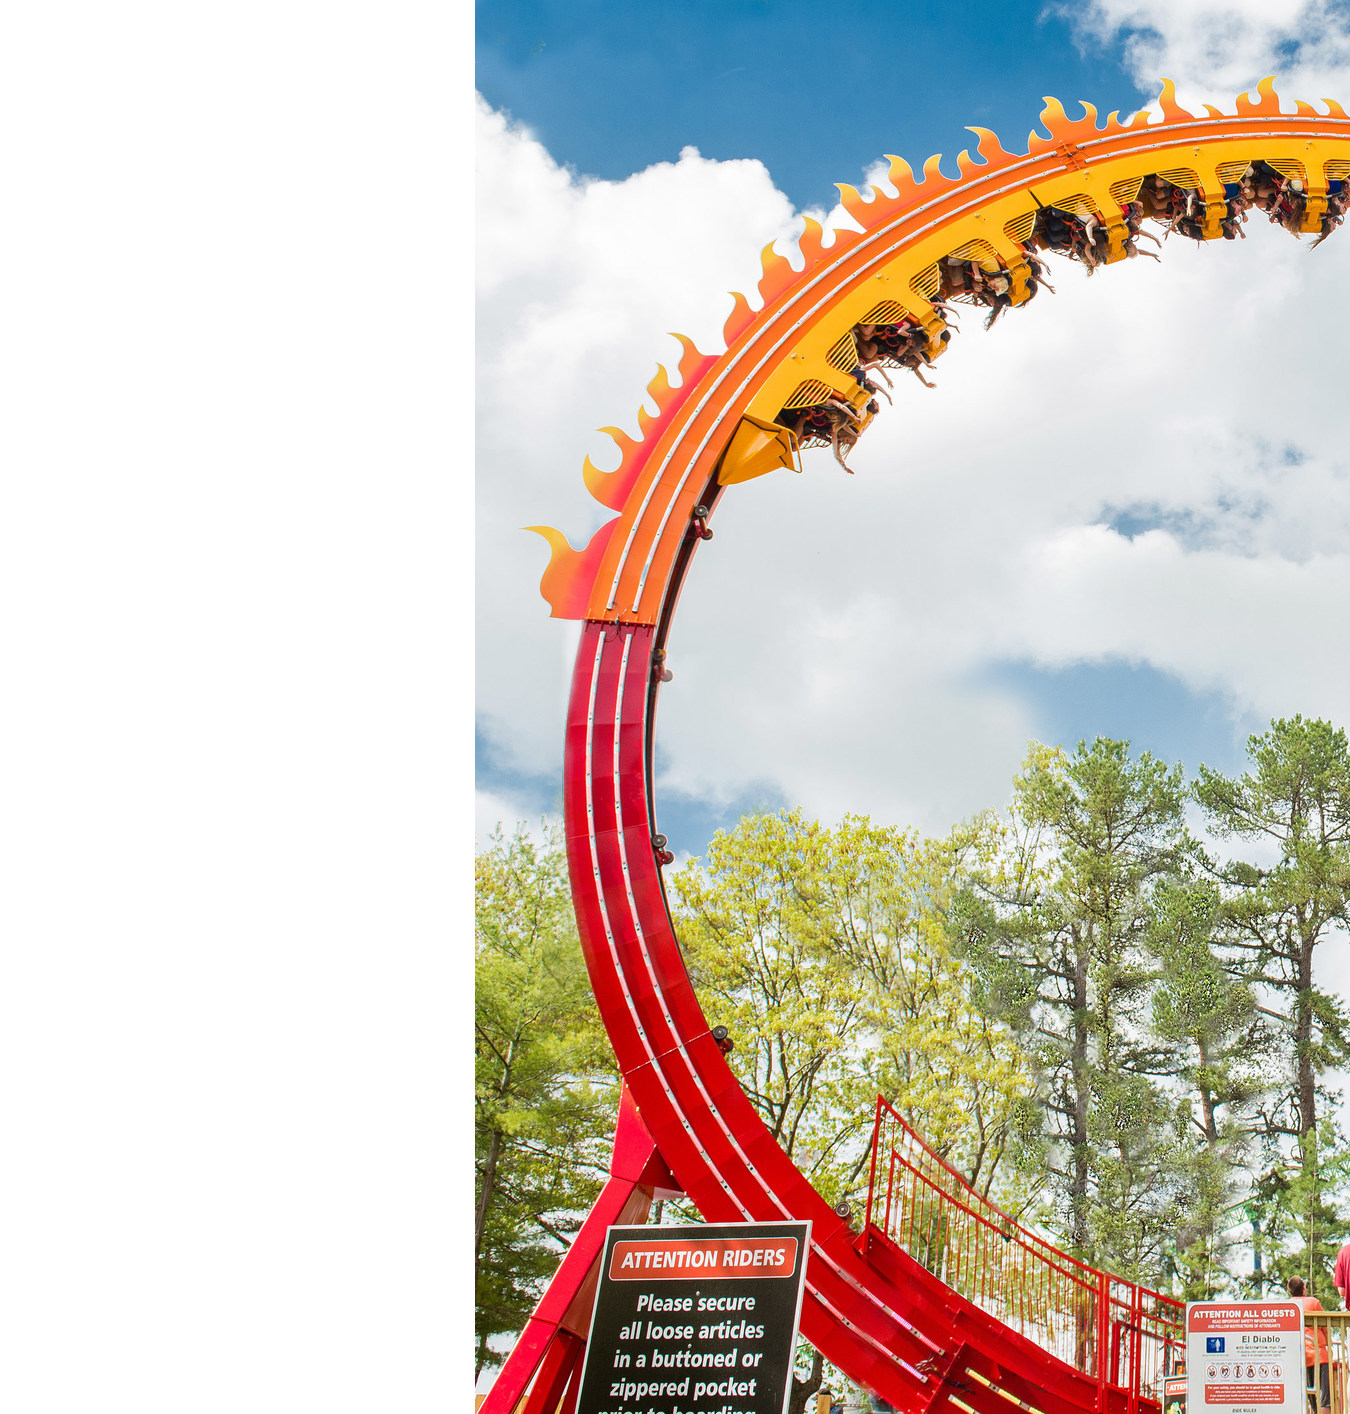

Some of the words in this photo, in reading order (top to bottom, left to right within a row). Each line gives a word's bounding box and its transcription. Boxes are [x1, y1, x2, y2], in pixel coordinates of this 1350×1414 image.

[620, 1250, 718, 1269] ATTENTION
[722, 1248, 786, 1267] RIDERS
[636, 1294, 693, 1312] Please
[697, 1296, 756, 1311] secure
[1194, 1310, 1241, 1318] ATTENTION
[1261, 1309, 1295, 1317] GUESTS
[619, 1321, 642, 1340] all
[646, 1321, 694, 1340] loose
[698, 1320, 765, 1339] articles
[613, 1349, 630, 1368] in
[635, 1353, 647, 1368] a
[651, 1348, 738, 1368] buttoned
[741, 1352, 763, 1367] or
[610, 1377, 690, 1401] zippered
[693, 1377, 757, 1401] pocket
